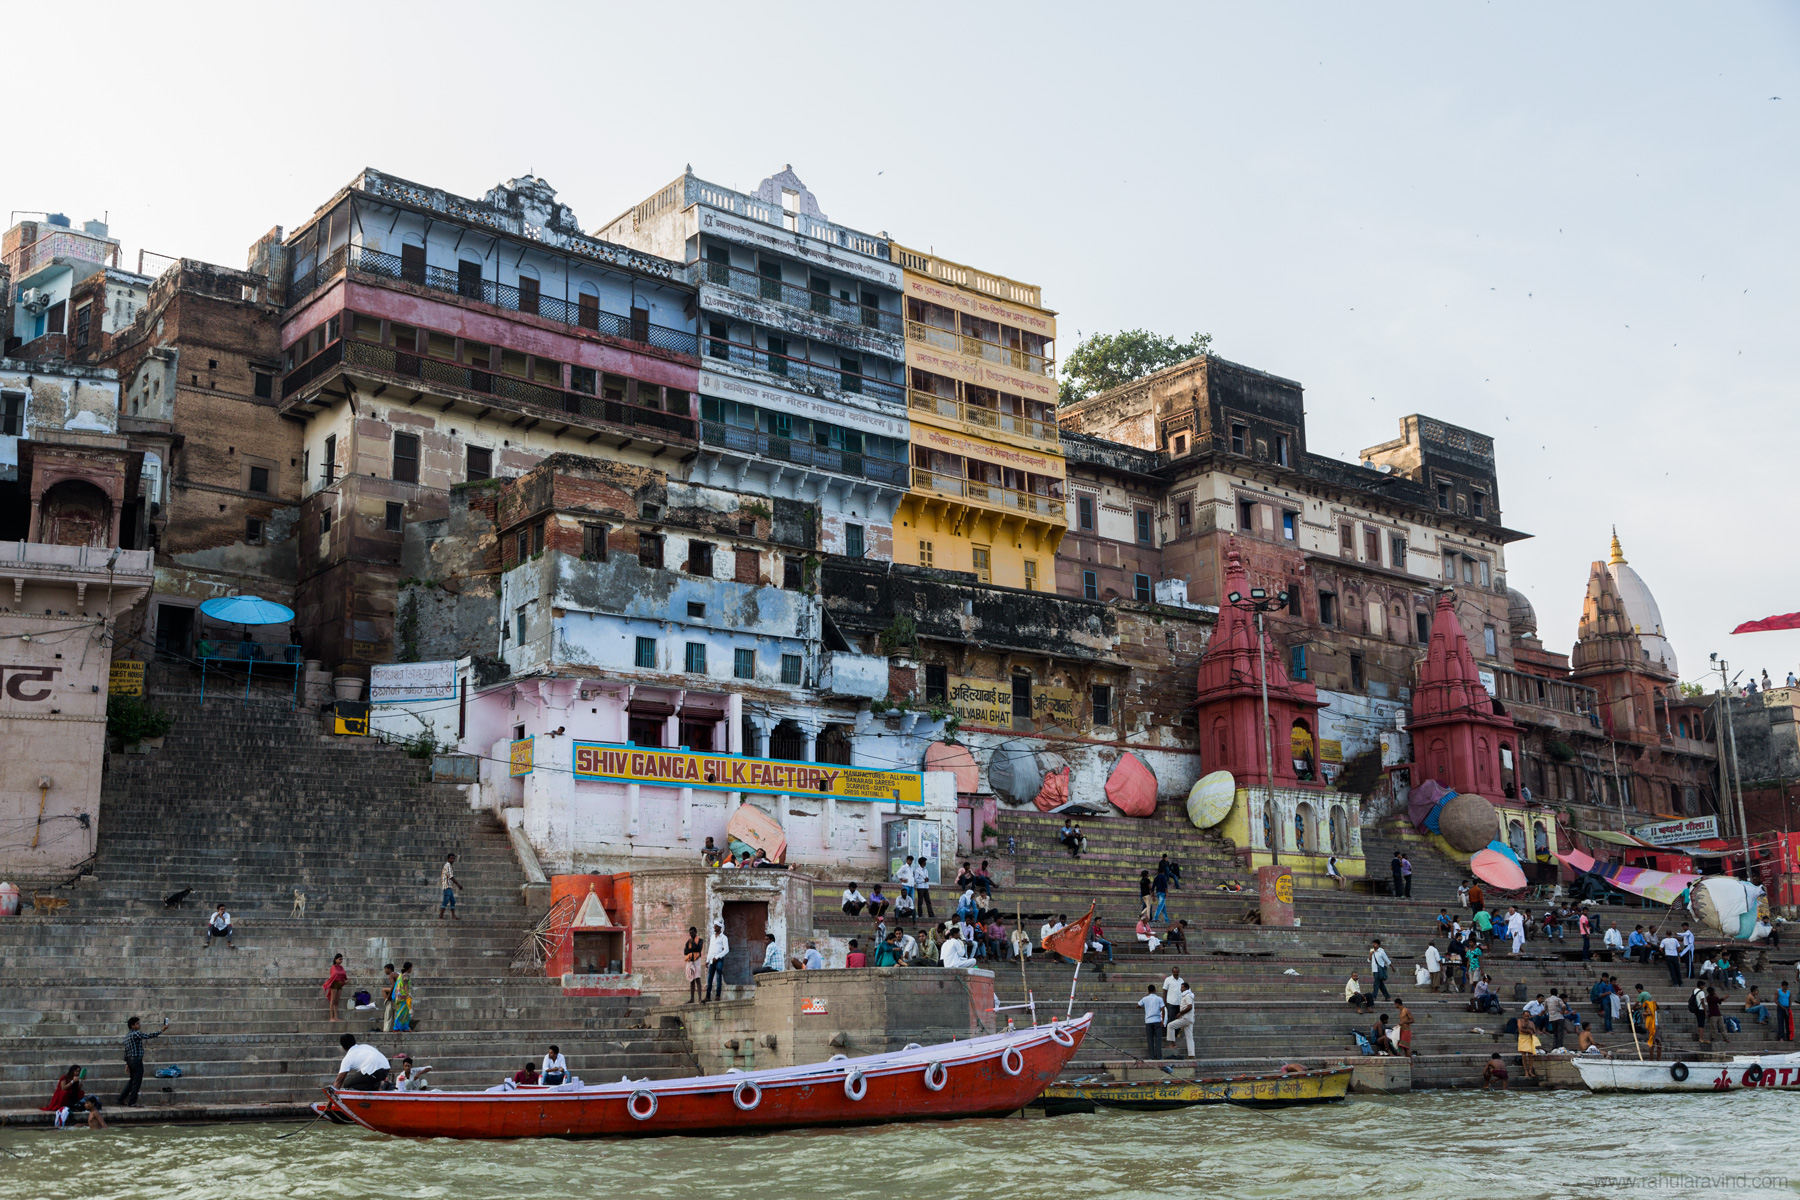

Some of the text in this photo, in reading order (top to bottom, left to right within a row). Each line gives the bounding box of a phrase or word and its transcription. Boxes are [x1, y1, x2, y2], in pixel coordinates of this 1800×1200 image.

[723, 380, 758, 397] कविराज
[762, 390, 782, 403] मदन
[786, 394, 809, 409] मोहन
[848, 411, 886, 428] कविरत्न
[110, 661, 130, 669] HADRA
[109, 669, 143, 678] GUEST HOUSE
[949, 683, 996, 705] अहिल्याबाई
[989, 709, 1010, 724] GHAT
[577, 748, 840, 792] SHIV GANGA SILK FACTORY
[843, 770, 886, 779] MANUFACTURES
[845, 776, 896, 787] BANARASI SAREES
[846, 783, 890, 792] SCARVES SUITS
[844, 789, 884, 798] DRESS MATERIALS
[1685, 820, 1705, 831] गीता
